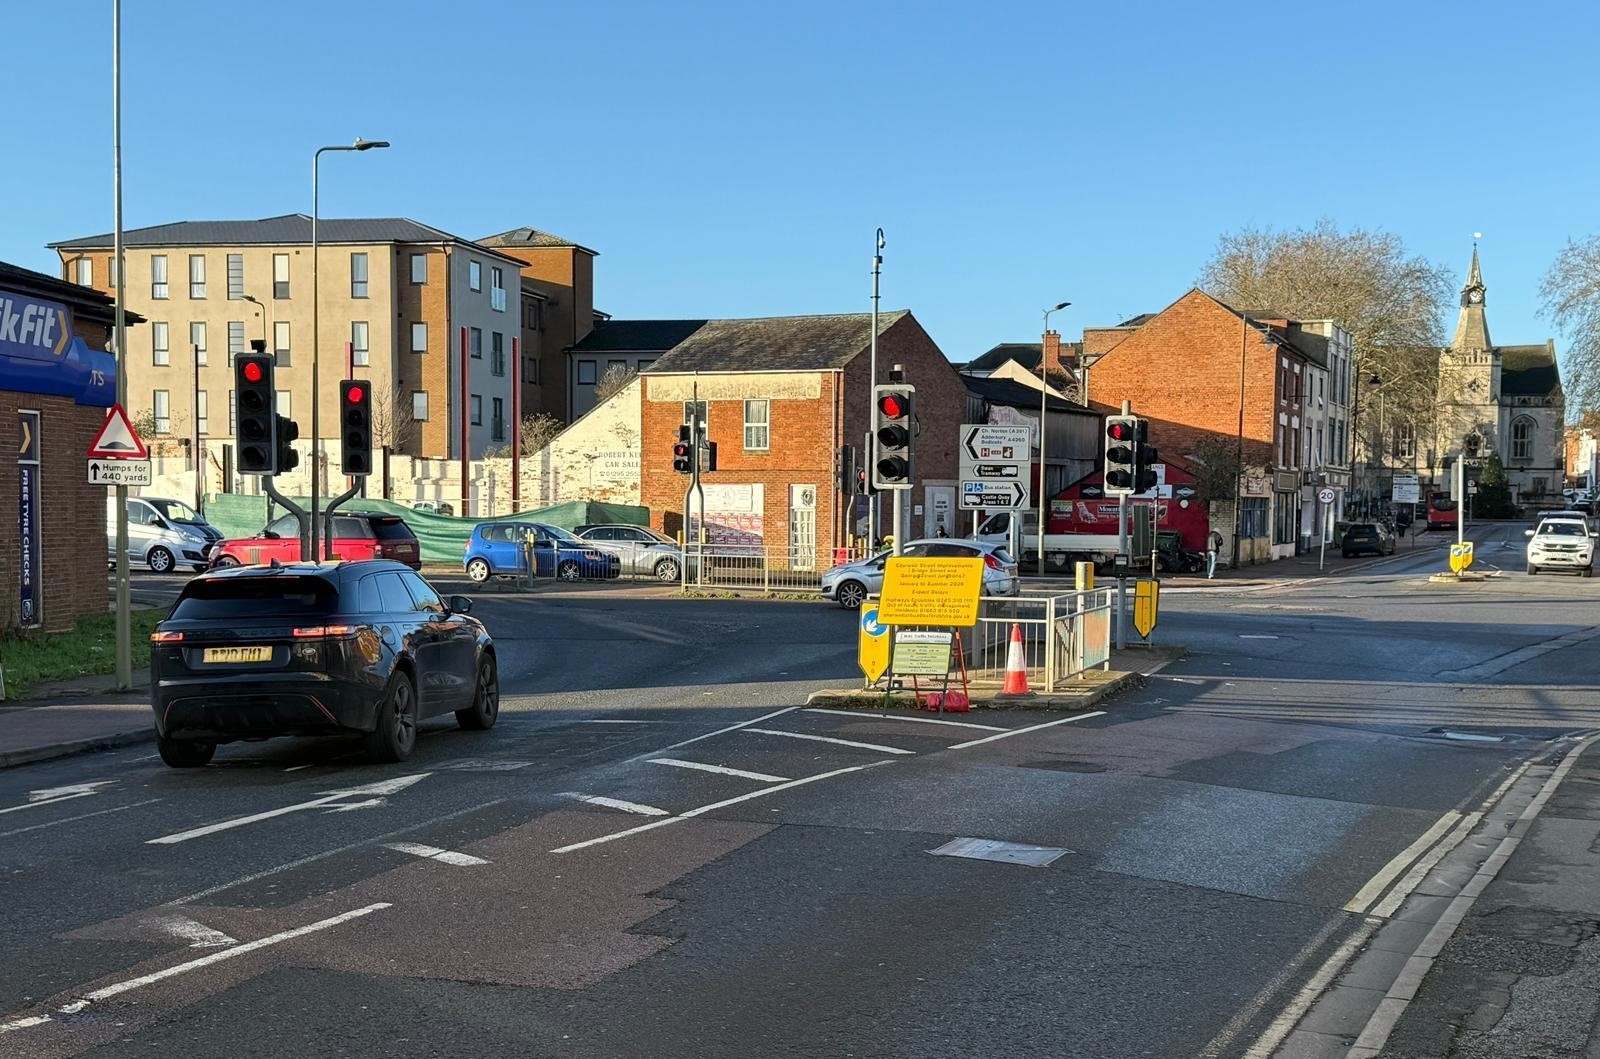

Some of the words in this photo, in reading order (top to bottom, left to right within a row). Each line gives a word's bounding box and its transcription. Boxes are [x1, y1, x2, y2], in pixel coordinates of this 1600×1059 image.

[102, 463, 131, 472] Humps
[134, 464, 146, 472] for
[101, 472, 121, 480] 440
[124, 474, 148, 482] yards
[1320, 492, 1333, 500] 20
